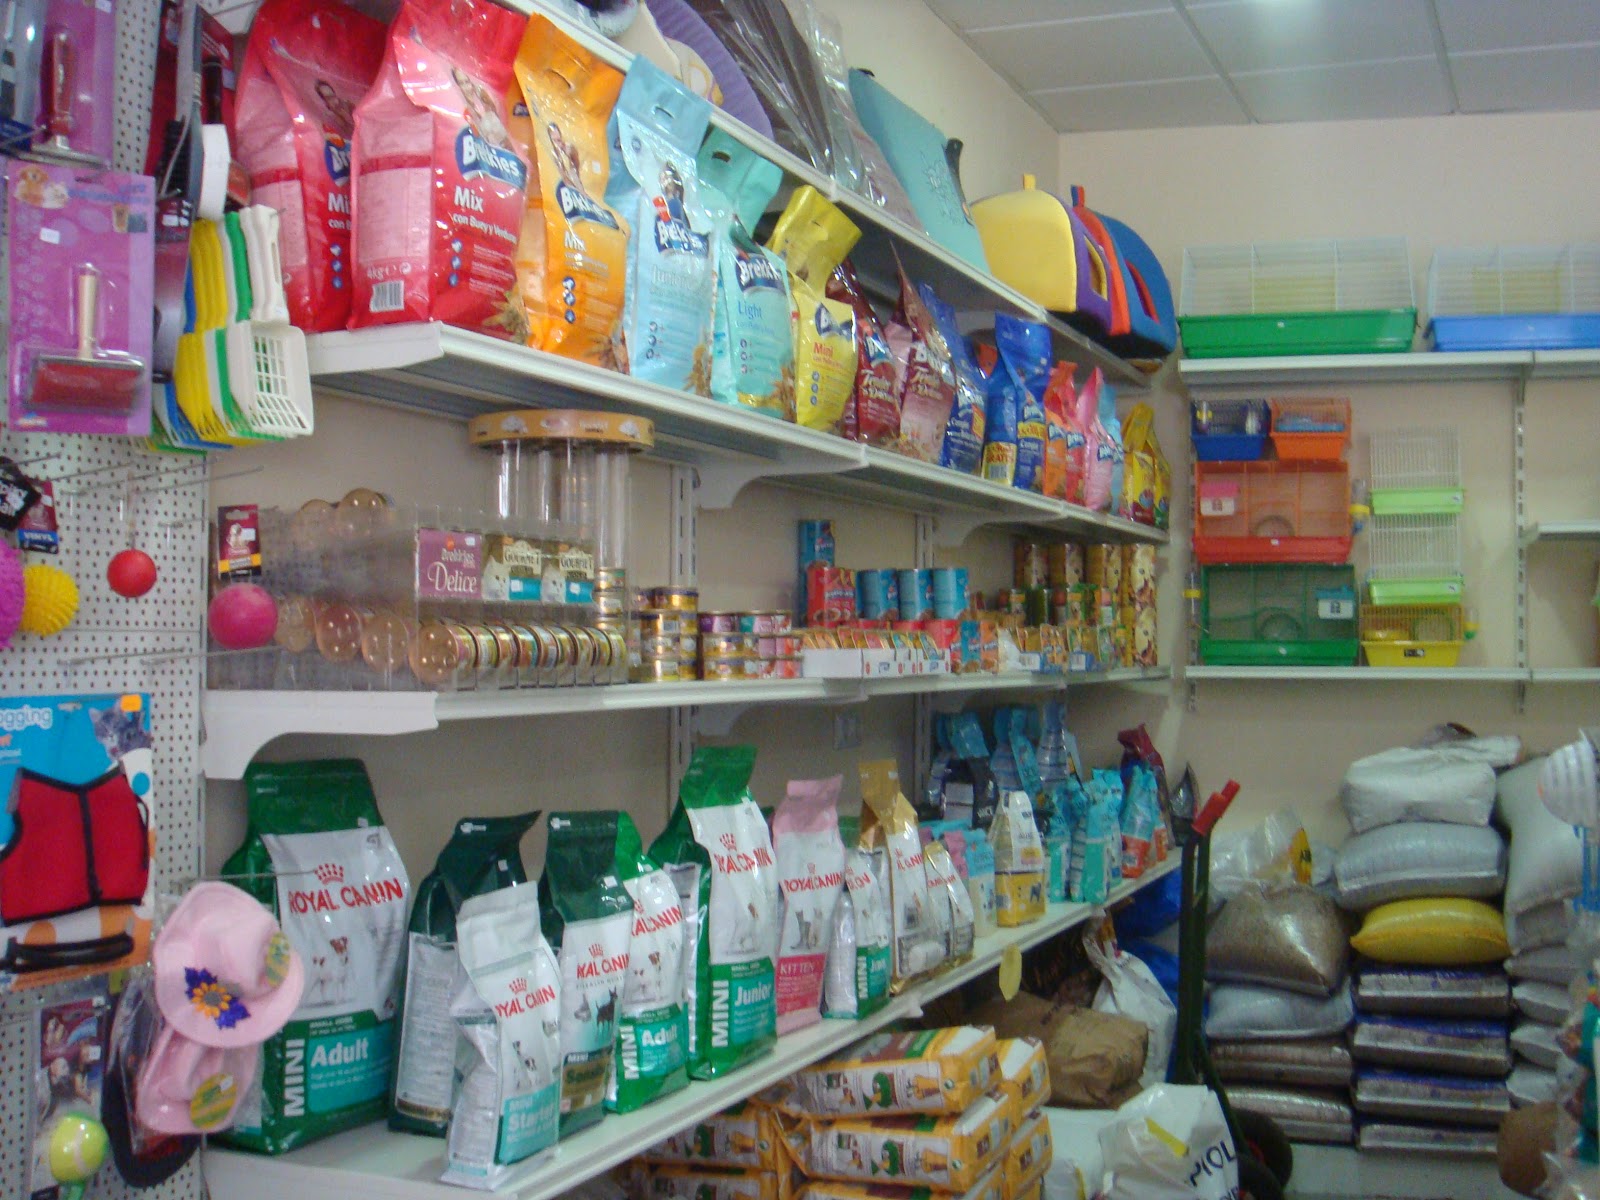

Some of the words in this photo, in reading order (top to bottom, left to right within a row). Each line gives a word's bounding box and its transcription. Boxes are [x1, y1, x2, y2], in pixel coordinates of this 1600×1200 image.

[327, 191, 351, 214] Mi
[453, 185, 484, 213] Mix
[453, 213, 469, 226] con
[737, 301, 762, 321] Light
[813, 341, 834, 357] Mini
[426, 560, 478, 594] Delice
[288, 888, 340, 915] ROYAL
[340, 877, 404, 909] CANIN
[779, 961, 816, 975] KITTEN
[857, 955, 868, 999] MINI
[710, 979, 729, 1048] MINI
[734, 981, 773, 1007] Junior
[619, 1024, 640, 1081] MINI
[641, 1023, 679, 1048] Adult
[284, 1038, 306, 1118] MINI
[310, 1036, 370, 1069] Adult
